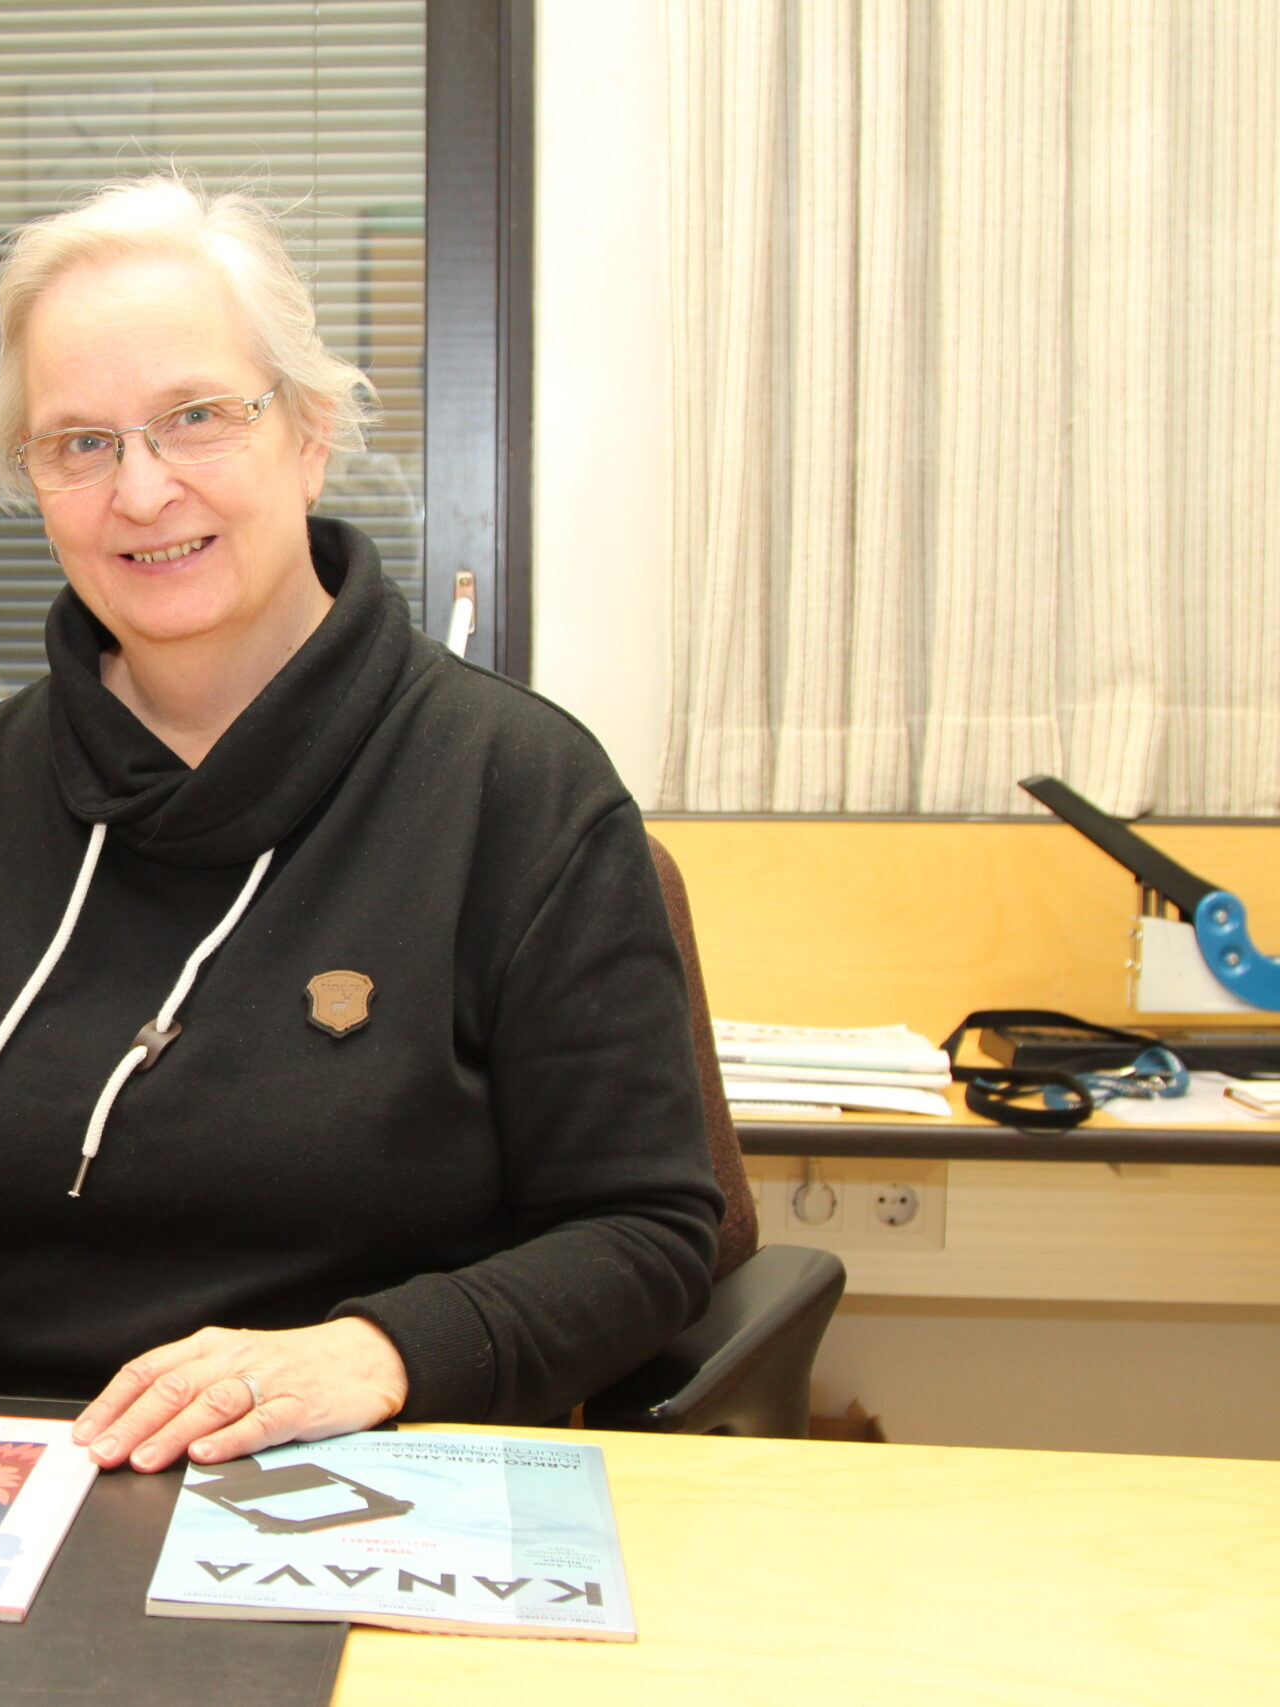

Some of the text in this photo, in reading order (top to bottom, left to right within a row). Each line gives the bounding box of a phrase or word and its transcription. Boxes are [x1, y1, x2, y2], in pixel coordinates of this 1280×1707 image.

[391, 1453, 580, 1469] JARKKO VESIKANSA
[514, 1455, 581, 1465] KUINKA
[195, 1560, 605, 1607] KANAVA
